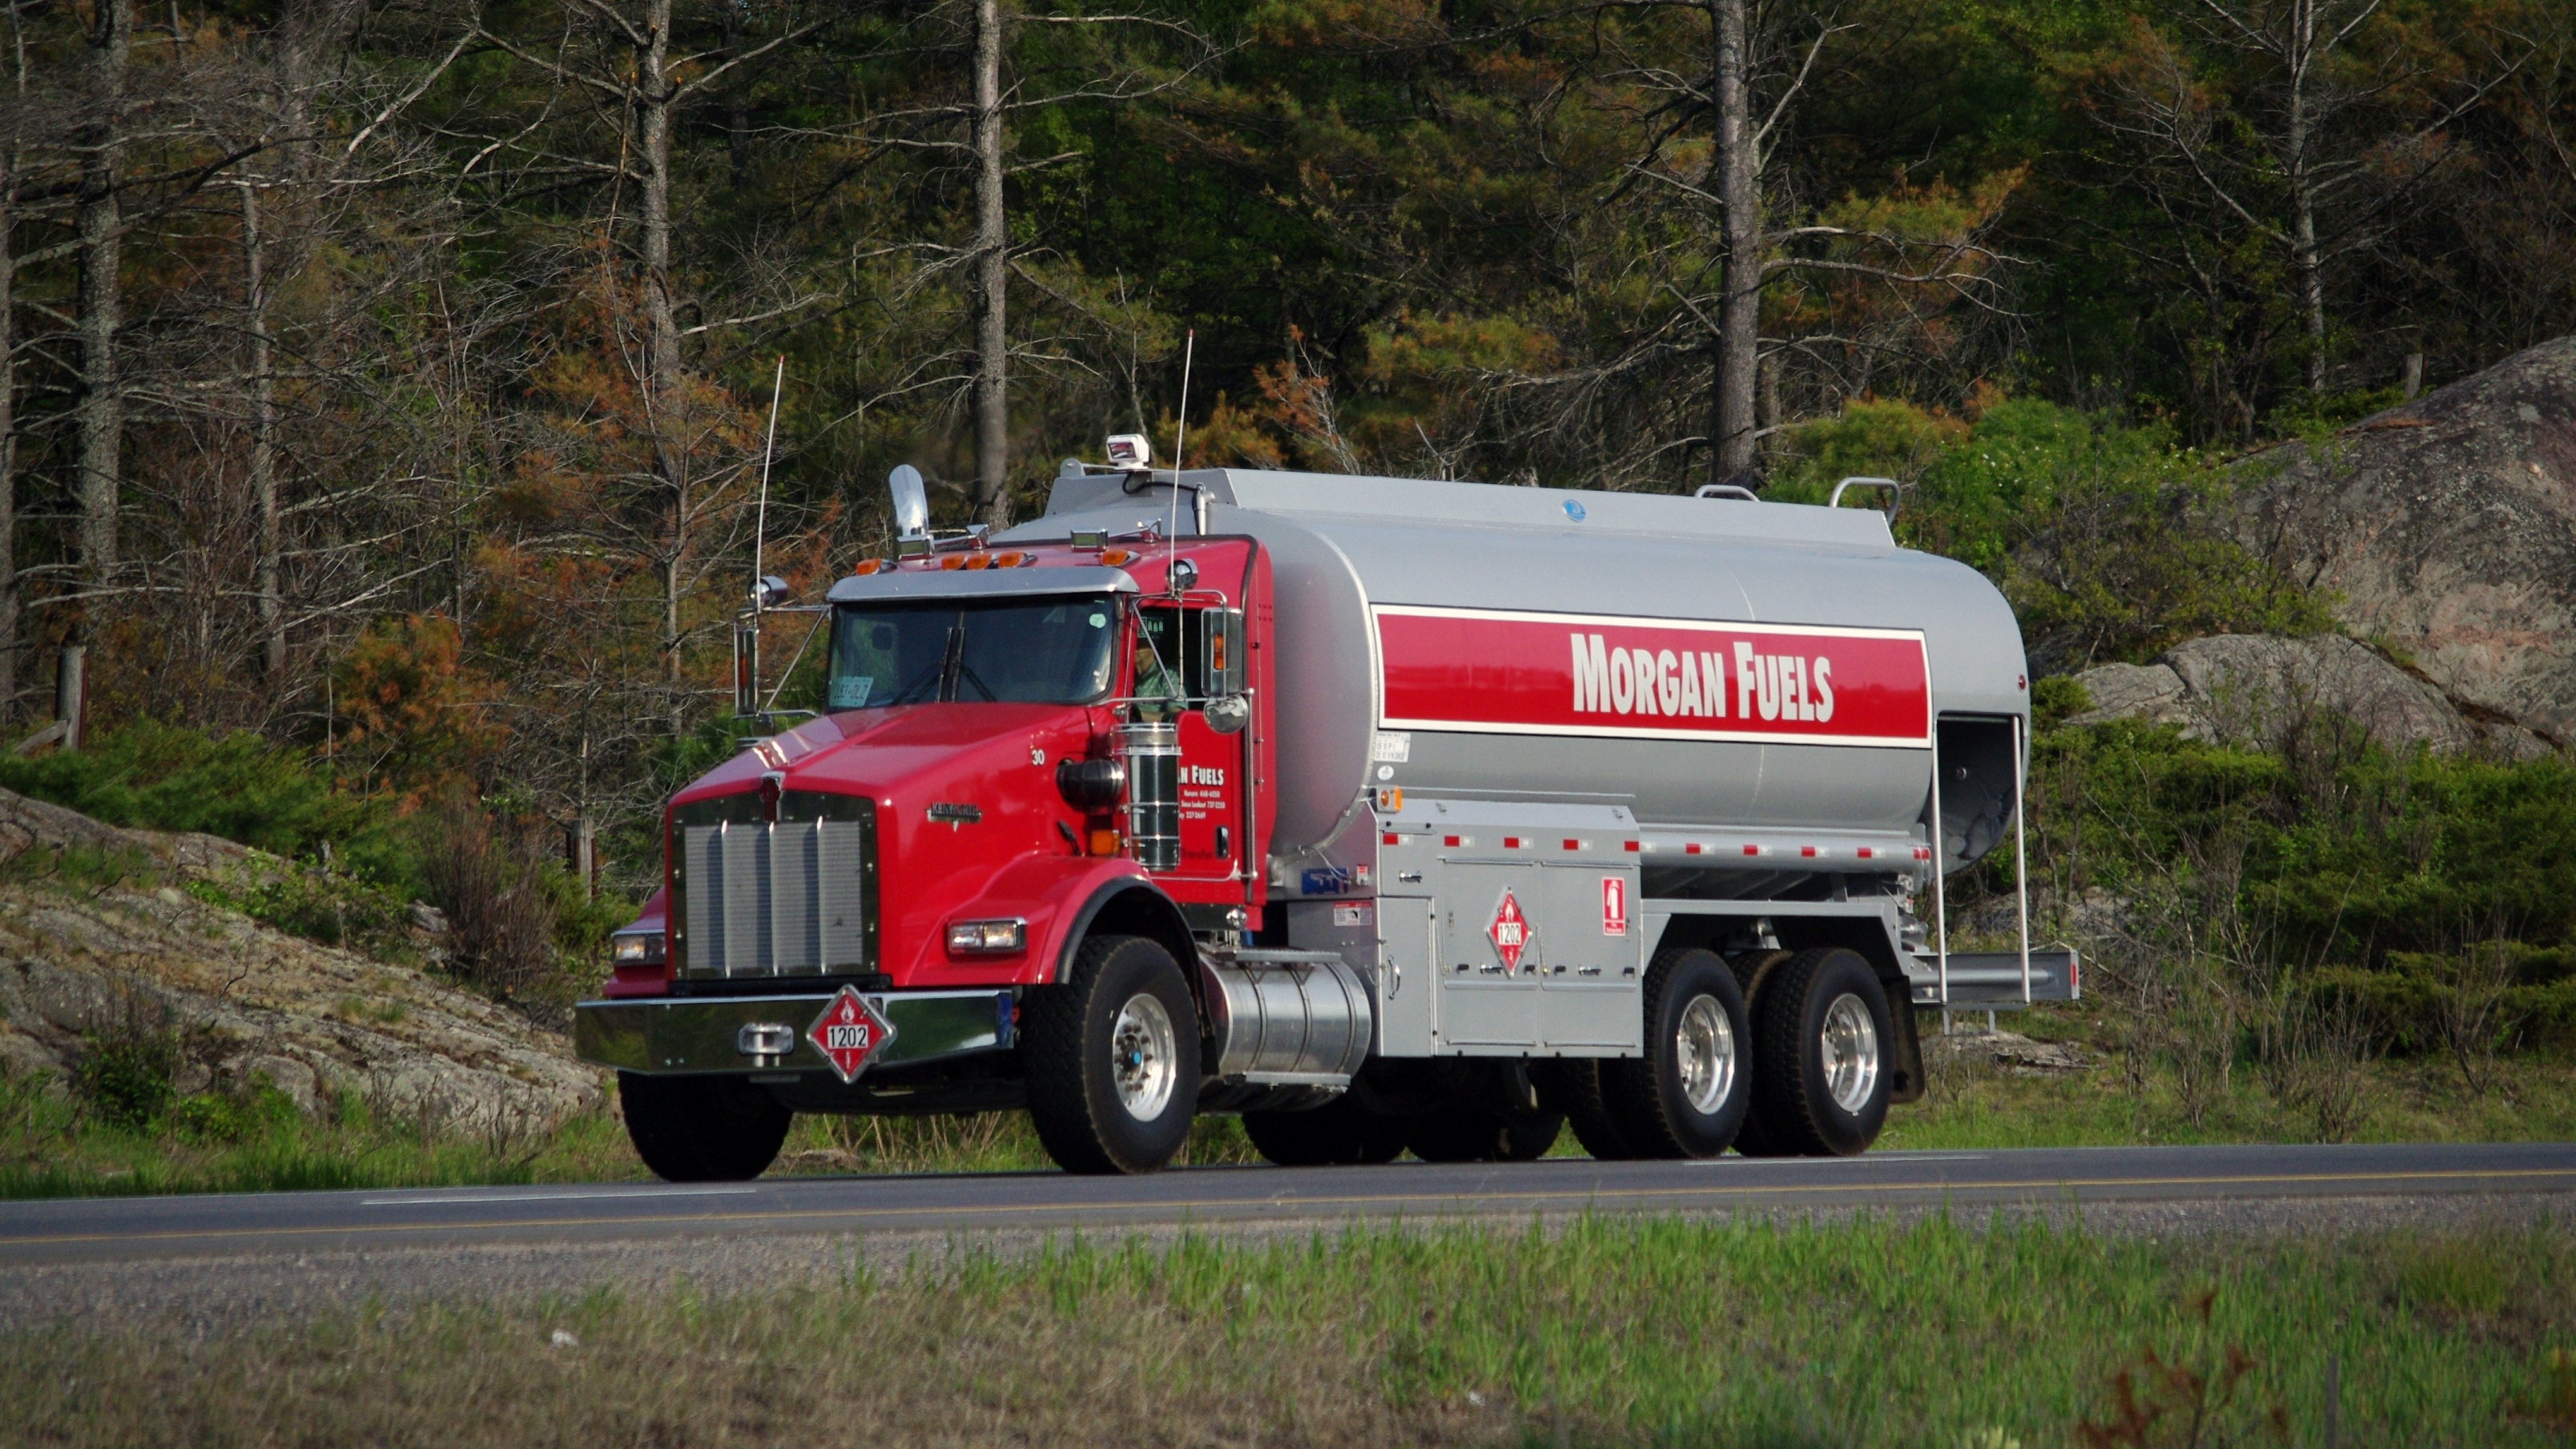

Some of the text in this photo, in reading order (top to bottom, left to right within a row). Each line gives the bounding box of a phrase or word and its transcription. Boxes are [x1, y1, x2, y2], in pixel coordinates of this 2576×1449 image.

[1032, 749, 1045, 766] 30
[1499, 924, 1519, 944] 1202
[829, 1027, 867, 1047] 1202
